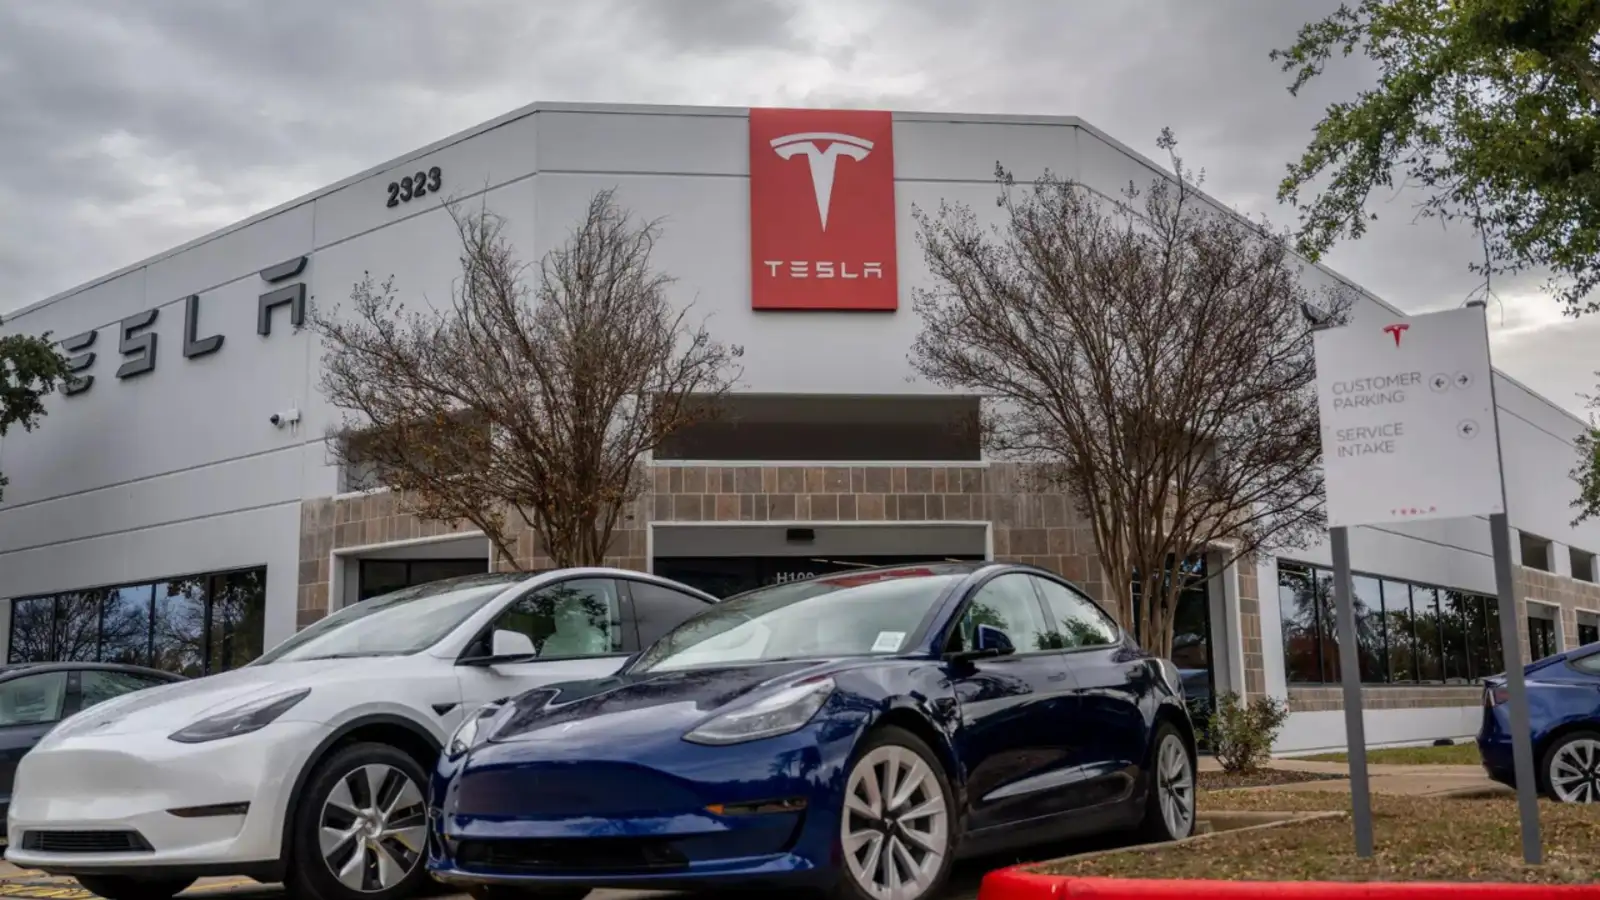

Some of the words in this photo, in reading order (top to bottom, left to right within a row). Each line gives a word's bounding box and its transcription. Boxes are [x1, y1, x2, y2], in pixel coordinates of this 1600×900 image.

[386, 166, 442, 208] 2323
[764, 260, 882, 278] TESLA
[58, 256, 308, 396] ESLA
[1332, 371, 1422, 395] CUSTOMER
[1333, 389, 1405, 411] PARKING
[1336, 422, 1404, 442] SERVICE
[1338, 439, 1395, 458] INTAKE
